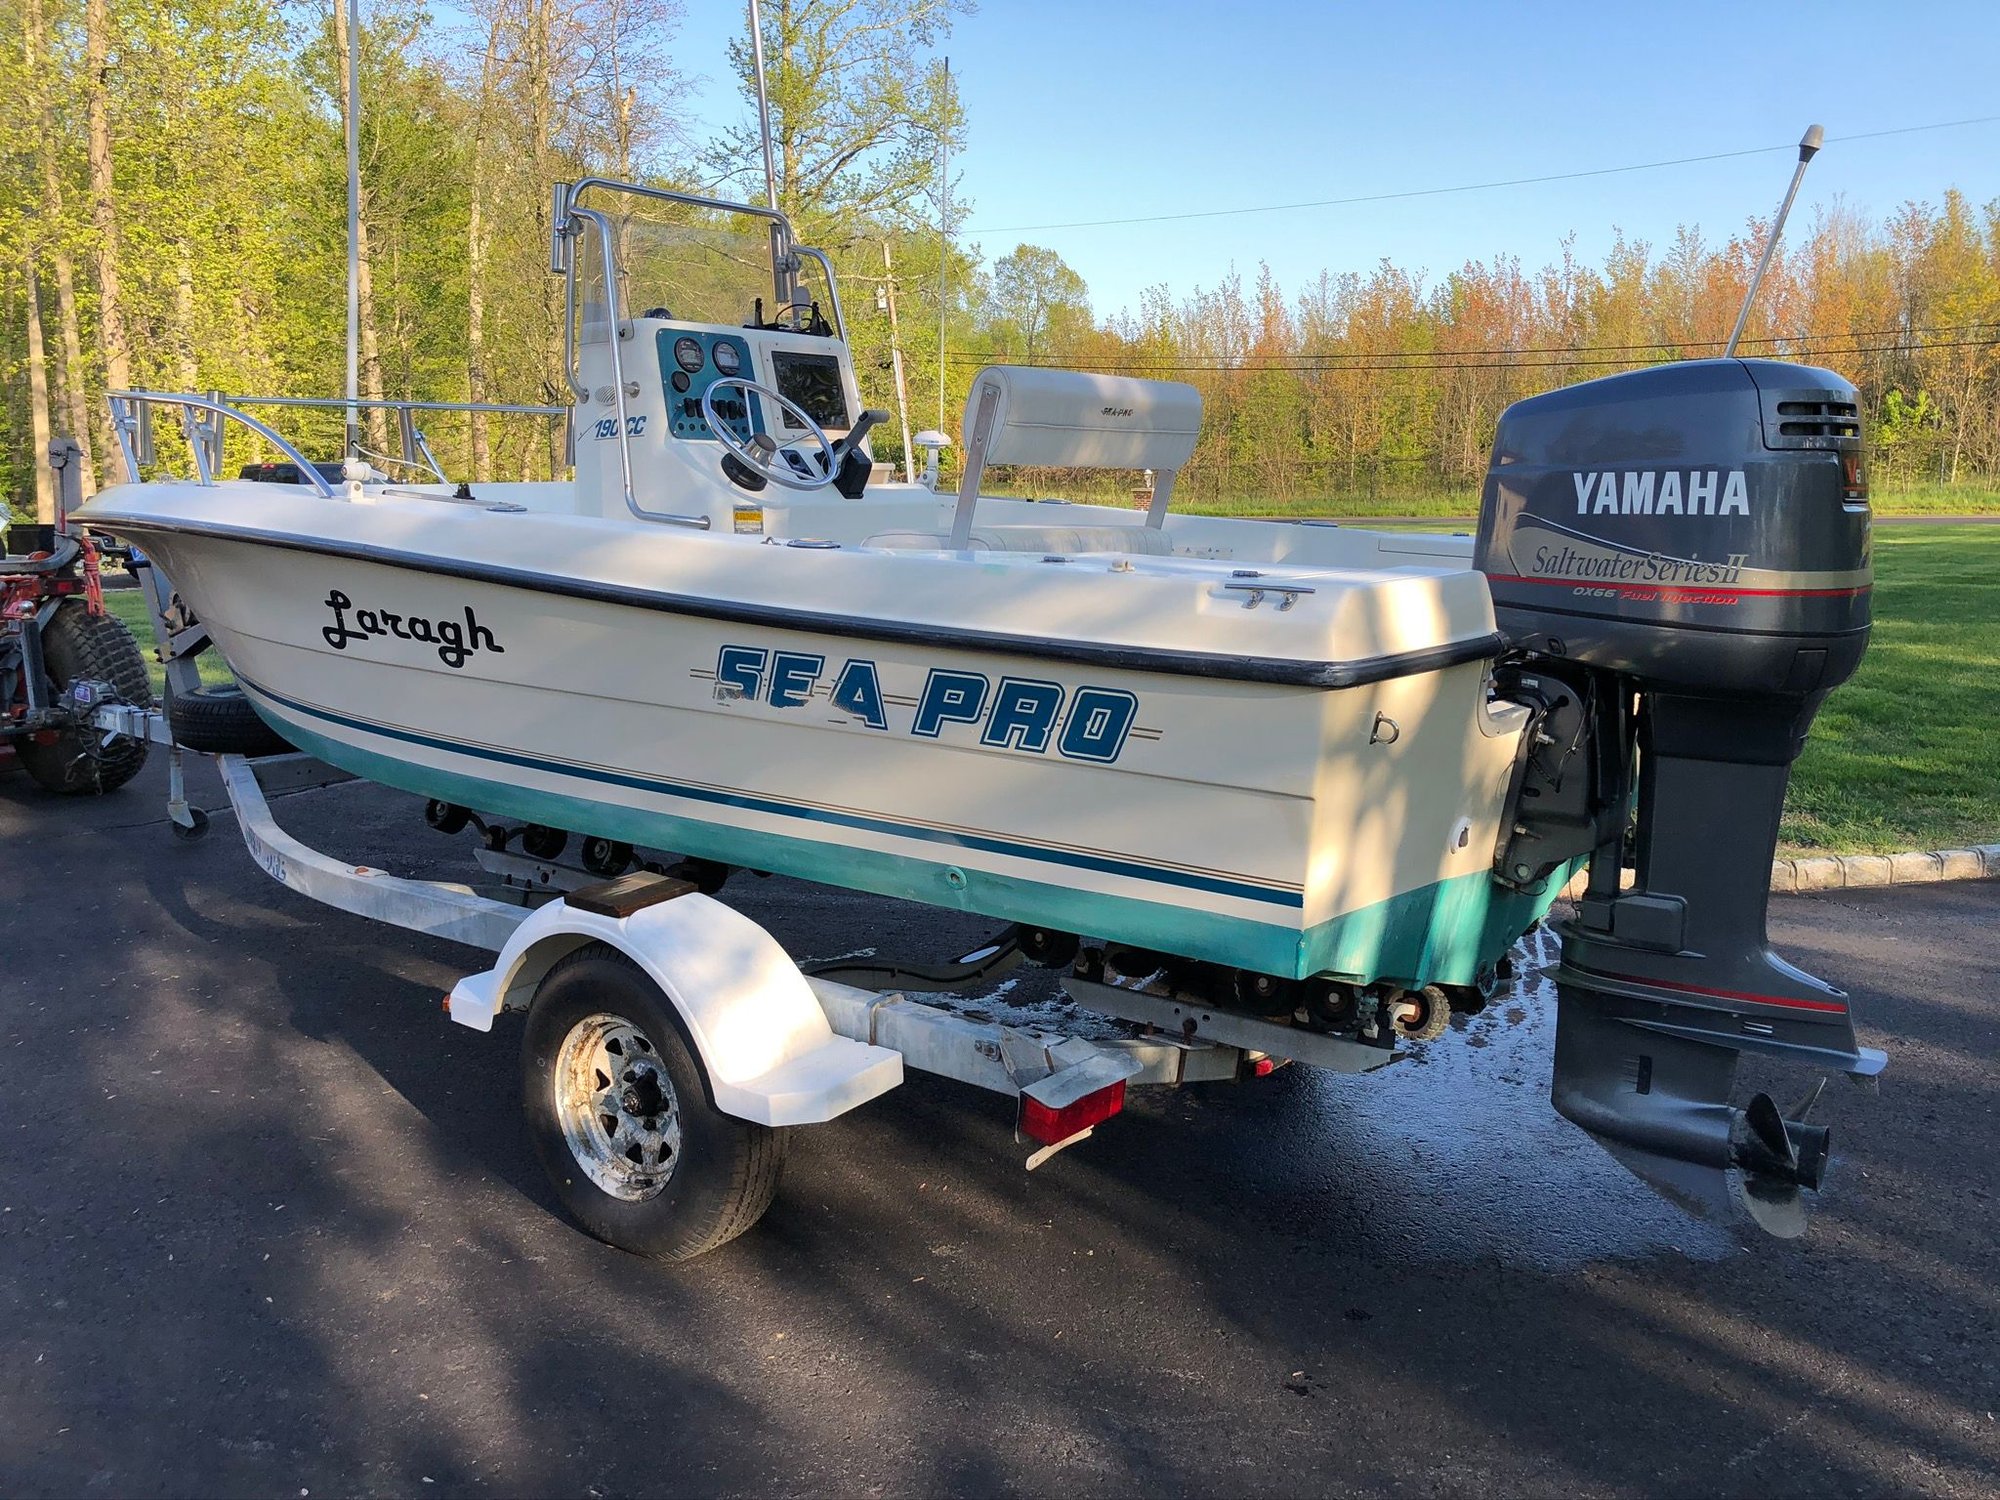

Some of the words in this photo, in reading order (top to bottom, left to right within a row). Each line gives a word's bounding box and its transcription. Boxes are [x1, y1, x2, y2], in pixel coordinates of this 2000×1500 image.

[1573, 471, 1750, 516] YAMAHA
[322, 589, 505, 669] Laragh
[1619, 590, 1657, 602] Fuel
[1659, 591, 1739, 606] Injection
[714, 644, 889, 731] SEA
[910, 667, 1139, 765] PRO
